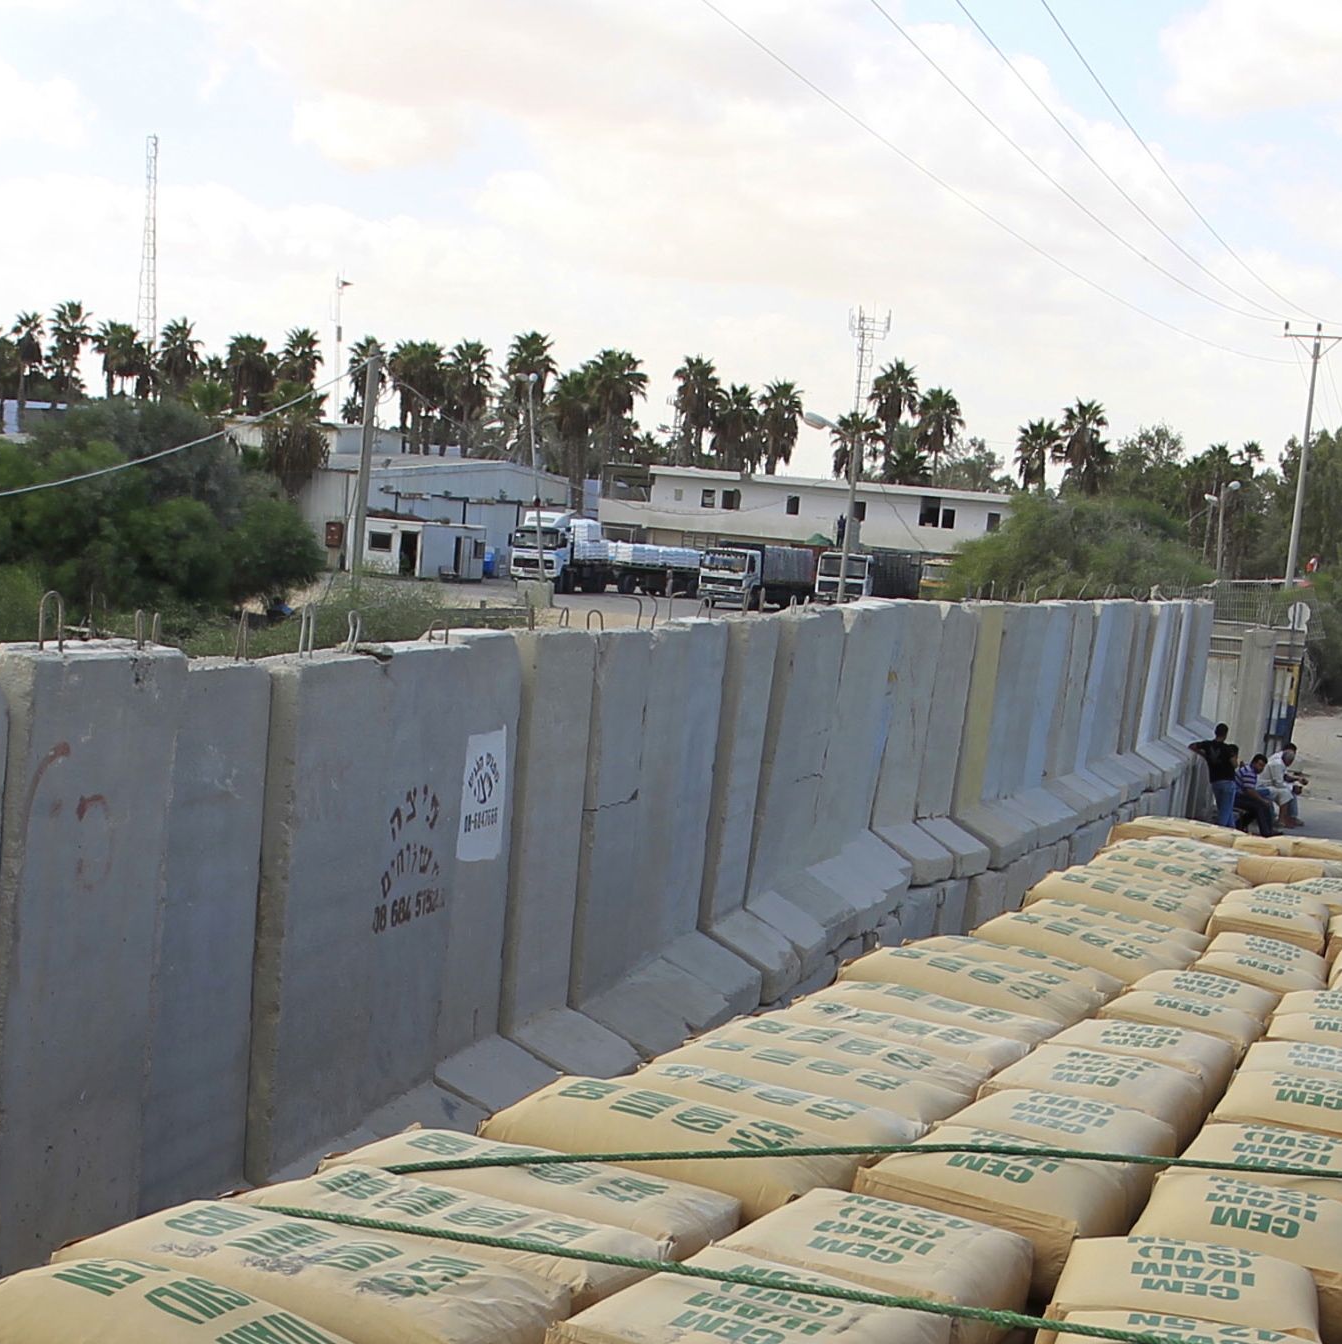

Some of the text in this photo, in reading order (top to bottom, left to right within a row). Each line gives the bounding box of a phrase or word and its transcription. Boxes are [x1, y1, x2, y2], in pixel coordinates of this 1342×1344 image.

[390, 784, 439, 842] פיצה
[373, 904, 387, 934] 08
[1154, 999, 1211, 1017] CEM
[1009, 1113, 1087, 1134] CEM
[1232, 1142, 1333, 1166] II/AM
[1244, 1131, 1335, 1153] (SVL)
[946, 1154, 1034, 1184] CEM
[164, 1204, 262, 1237] CEM
[1205, 1193, 1319, 1222] II/AM
[839, 1207, 946, 1239] (SVL)
[1210, 1206, 1300, 1239] CEM
[807, 1236, 904, 1264] CEM
[814, 1220, 936, 1255] II/AM
[1138, 1245, 1253, 1269] (SVL)
[1131, 1261, 1256, 1287] II/AM
[1140, 1278, 1240, 1301] CEM
